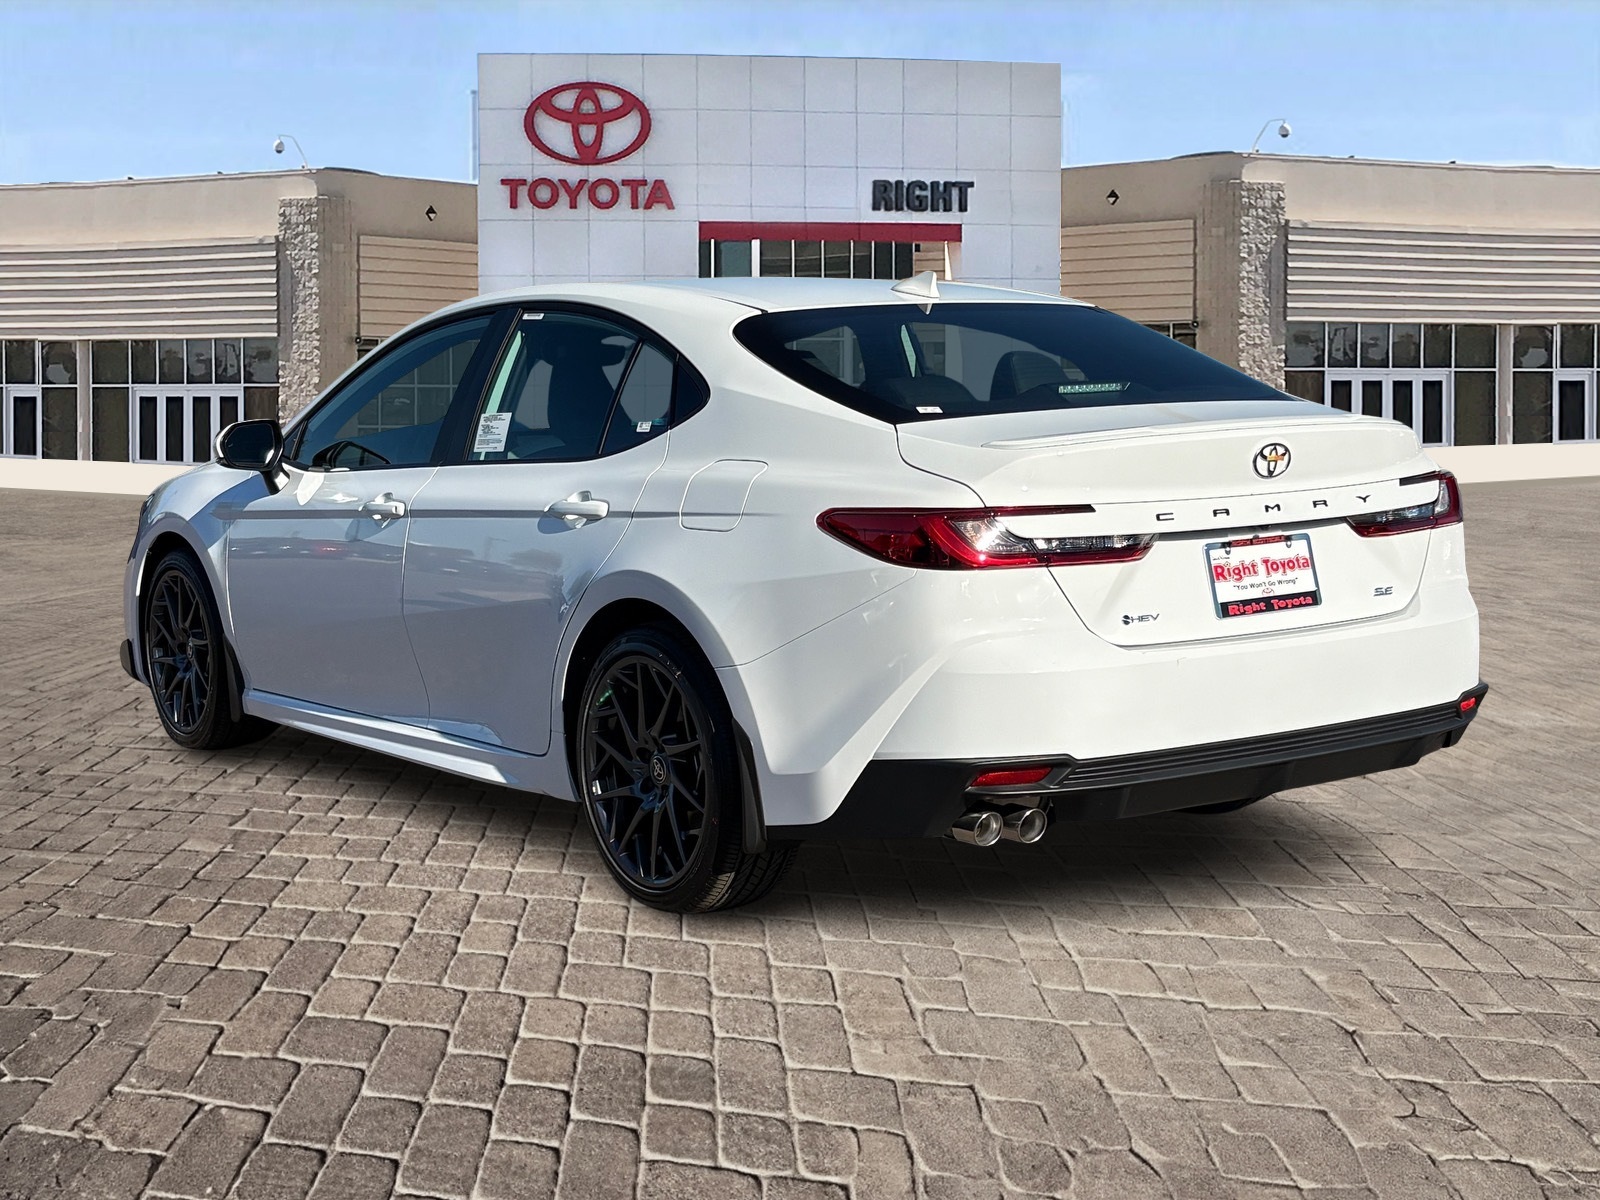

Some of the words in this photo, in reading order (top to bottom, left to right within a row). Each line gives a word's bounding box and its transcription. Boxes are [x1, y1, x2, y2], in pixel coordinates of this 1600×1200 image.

[500, 178, 675, 210] TOYOTA
[872, 179, 975, 212] RIGHT
[1156, 494, 1371, 521] CAMRY
[1213, 561, 1258, 582] Right
[1262, 555, 1311, 576] Toyota
[1249, 581, 1266, 590] Won't
[1373, 586, 1393, 597] SE
[1228, 603, 1266, 615] Right
[1271, 596, 1313, 609] Toyota
[1130, 613, 1160, 624] HEV
